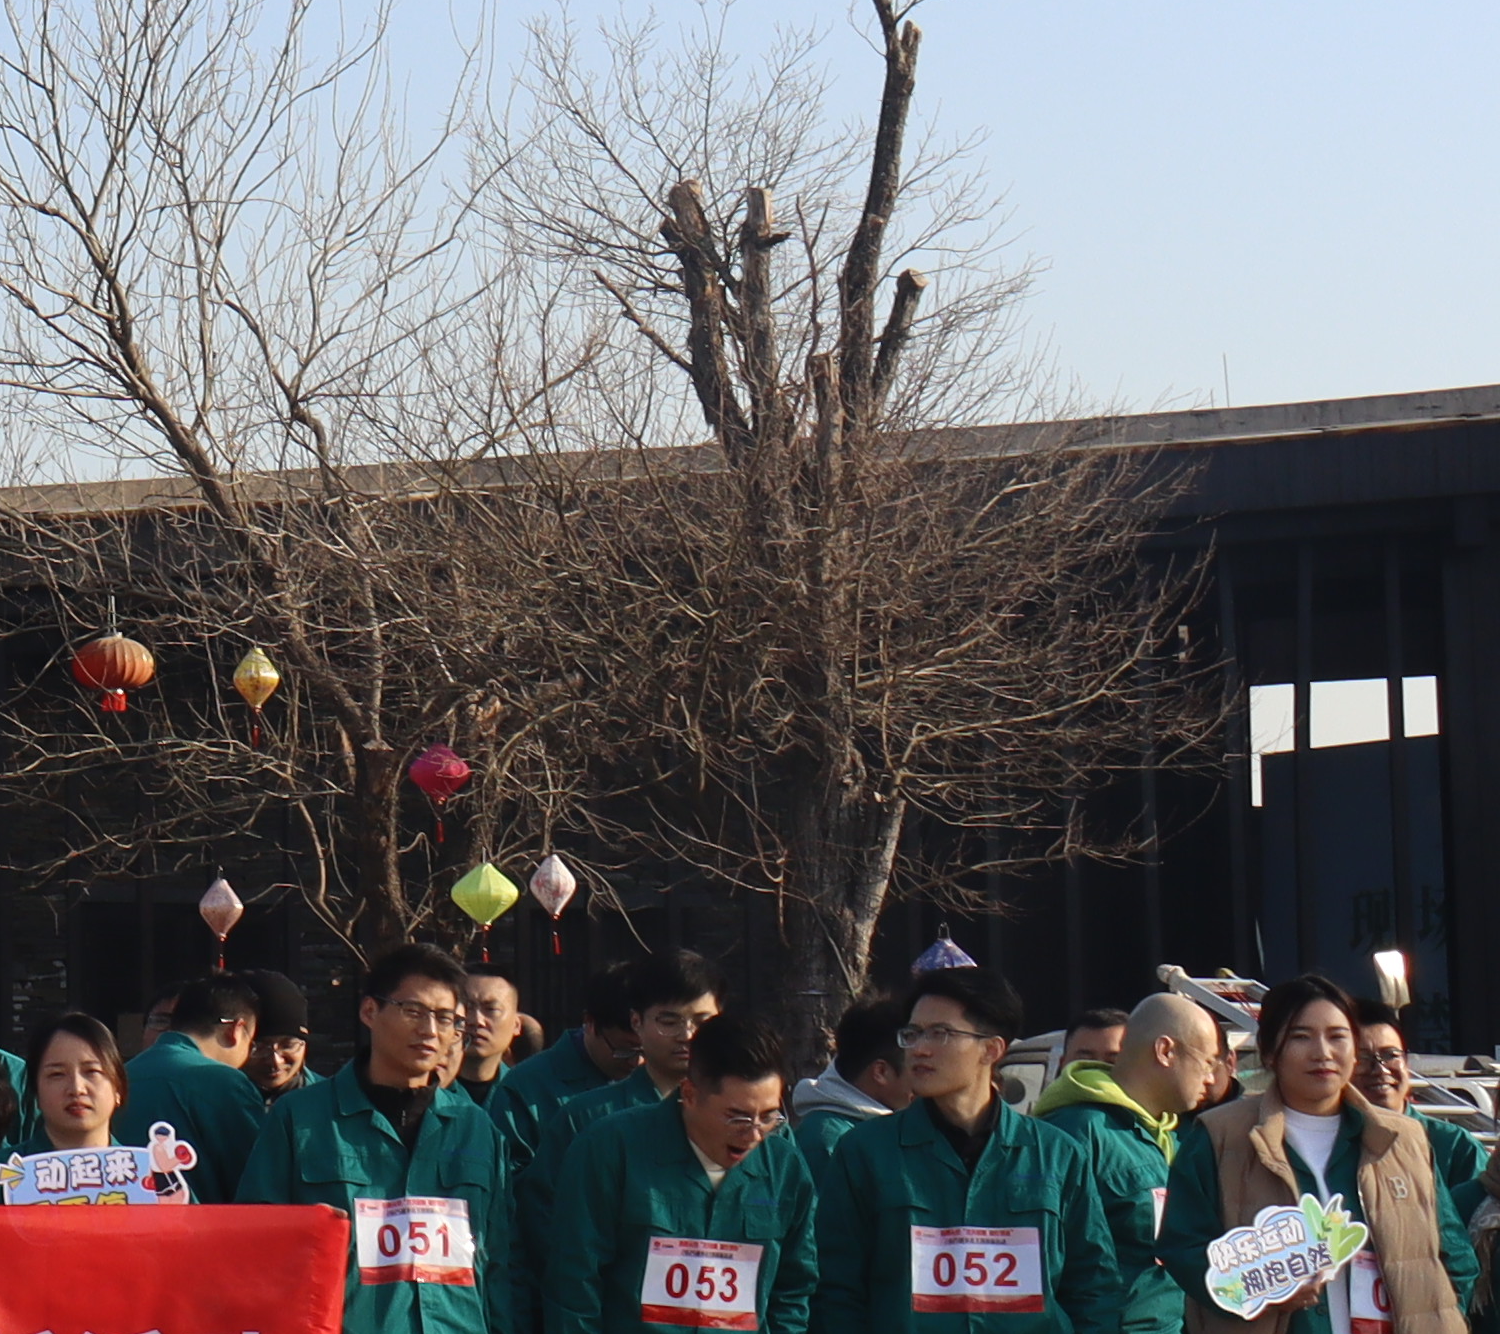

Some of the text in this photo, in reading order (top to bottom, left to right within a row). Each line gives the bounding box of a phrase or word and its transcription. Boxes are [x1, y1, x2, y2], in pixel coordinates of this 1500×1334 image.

[35, 1150, 138, 1194] 动起来
[377, 1221, 450, 1258] 051
[1211, 1216, 1306, 1273] 快乐运动
[665, 1263, 739, 1303] 053
[933, 1252, 1019, 1287] 052
[1240, 1243, 1334, 1298] 拥抱自然
